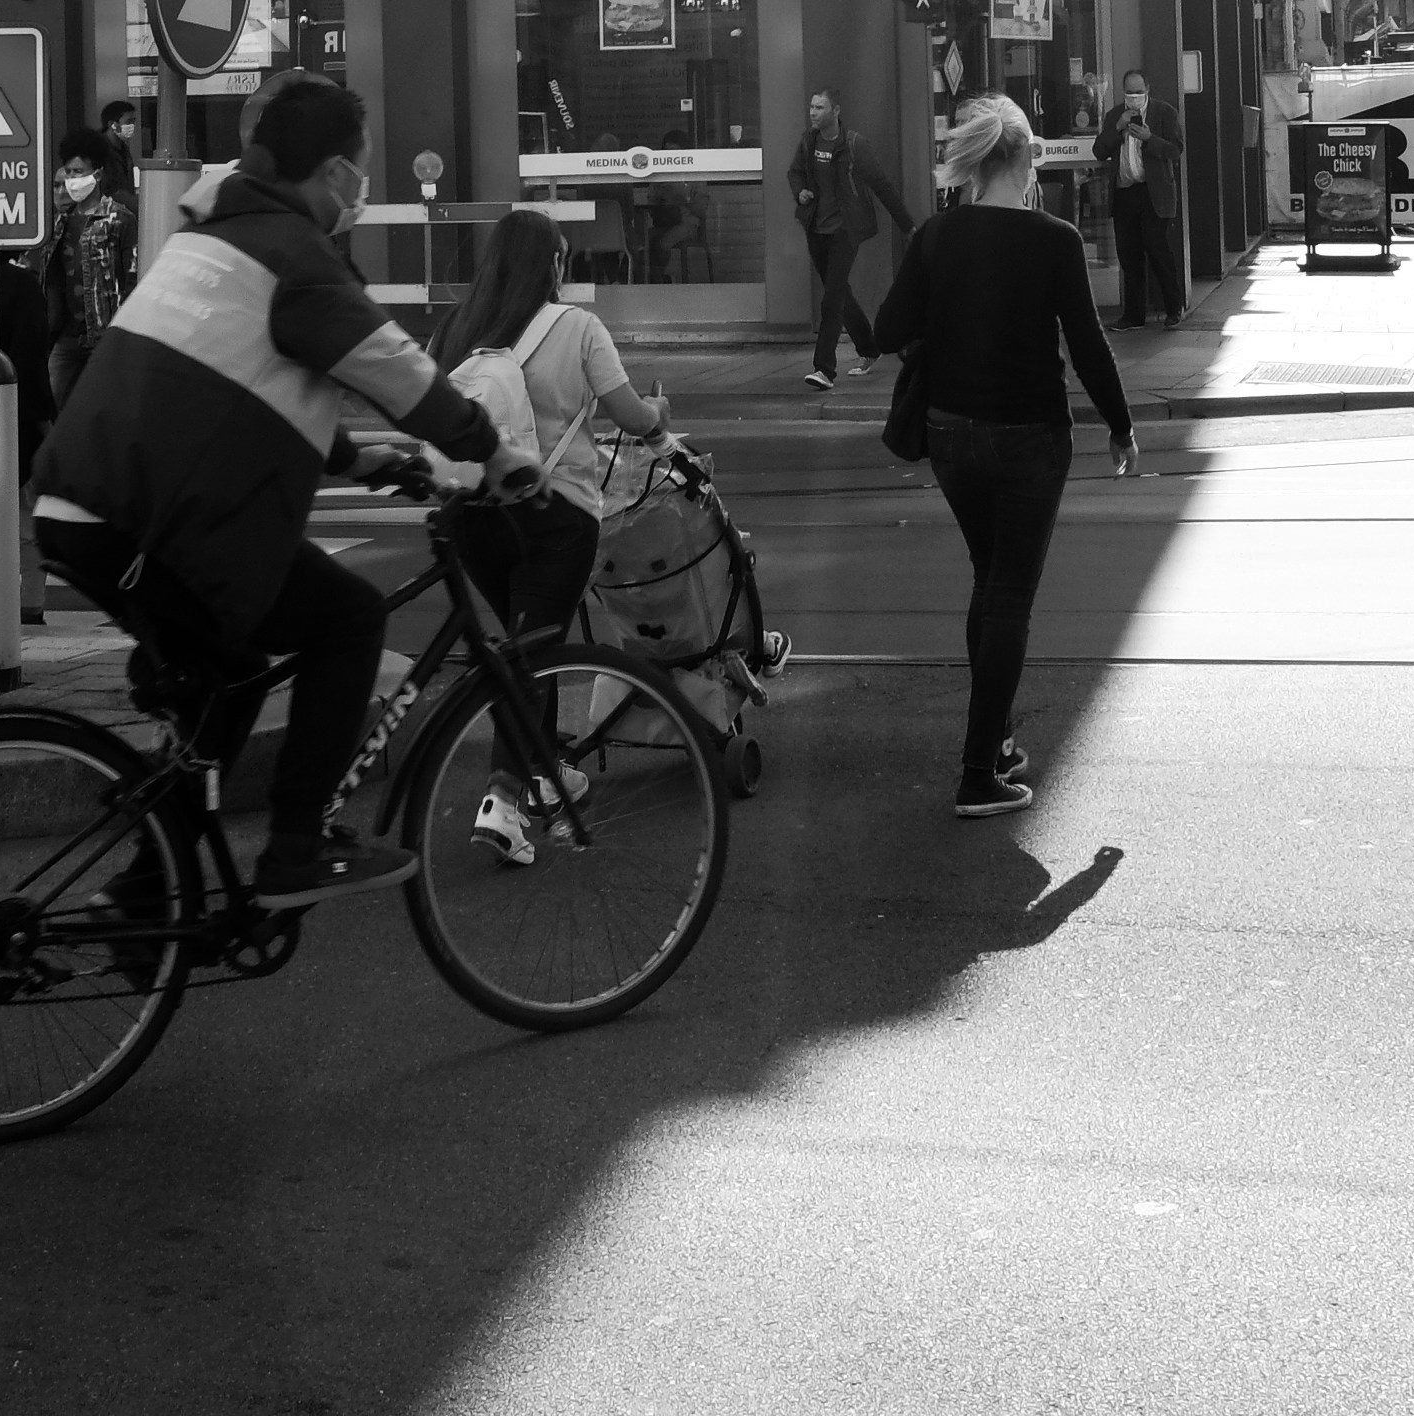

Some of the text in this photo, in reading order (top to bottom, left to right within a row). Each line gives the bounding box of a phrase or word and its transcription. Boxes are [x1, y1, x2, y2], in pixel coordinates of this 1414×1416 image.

[1045, 146, 1079, 156] BURGER
[1318, 142, 1377, 161] The Cheesy
[586, 157, 694, 168] MEDINA BURGER
[1333, 158, 1362, 173] Chick
